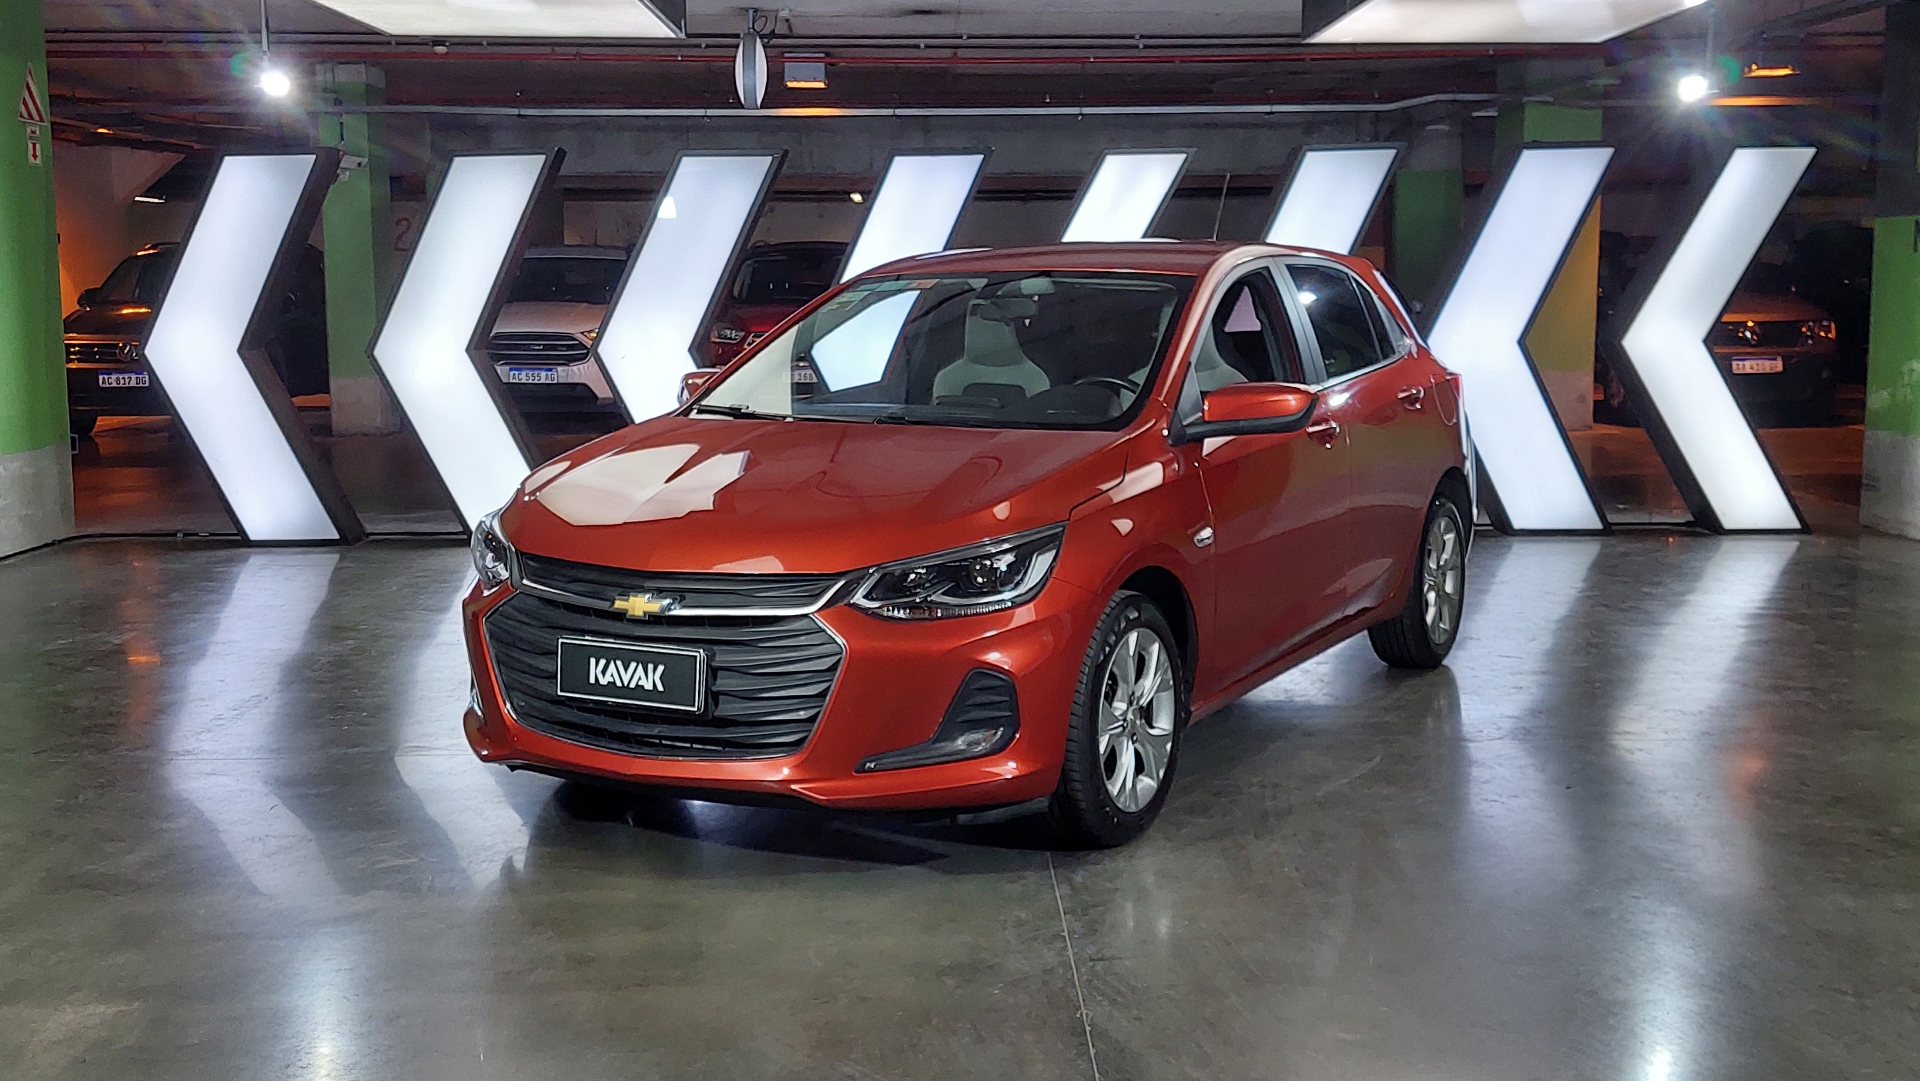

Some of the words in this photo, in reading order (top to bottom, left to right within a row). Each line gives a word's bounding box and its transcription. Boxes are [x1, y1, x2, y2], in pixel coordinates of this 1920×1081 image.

[394, 217, 412, 252] 2
[101, 376, 113, 386] AC
[135, 376, 147, 386] DG
[512, 372, 523, 382] AC
[525, 372, 542, 382] 555
[545, 373, 556, 382] AG
[588, 656, 665, 692] KAVAK
